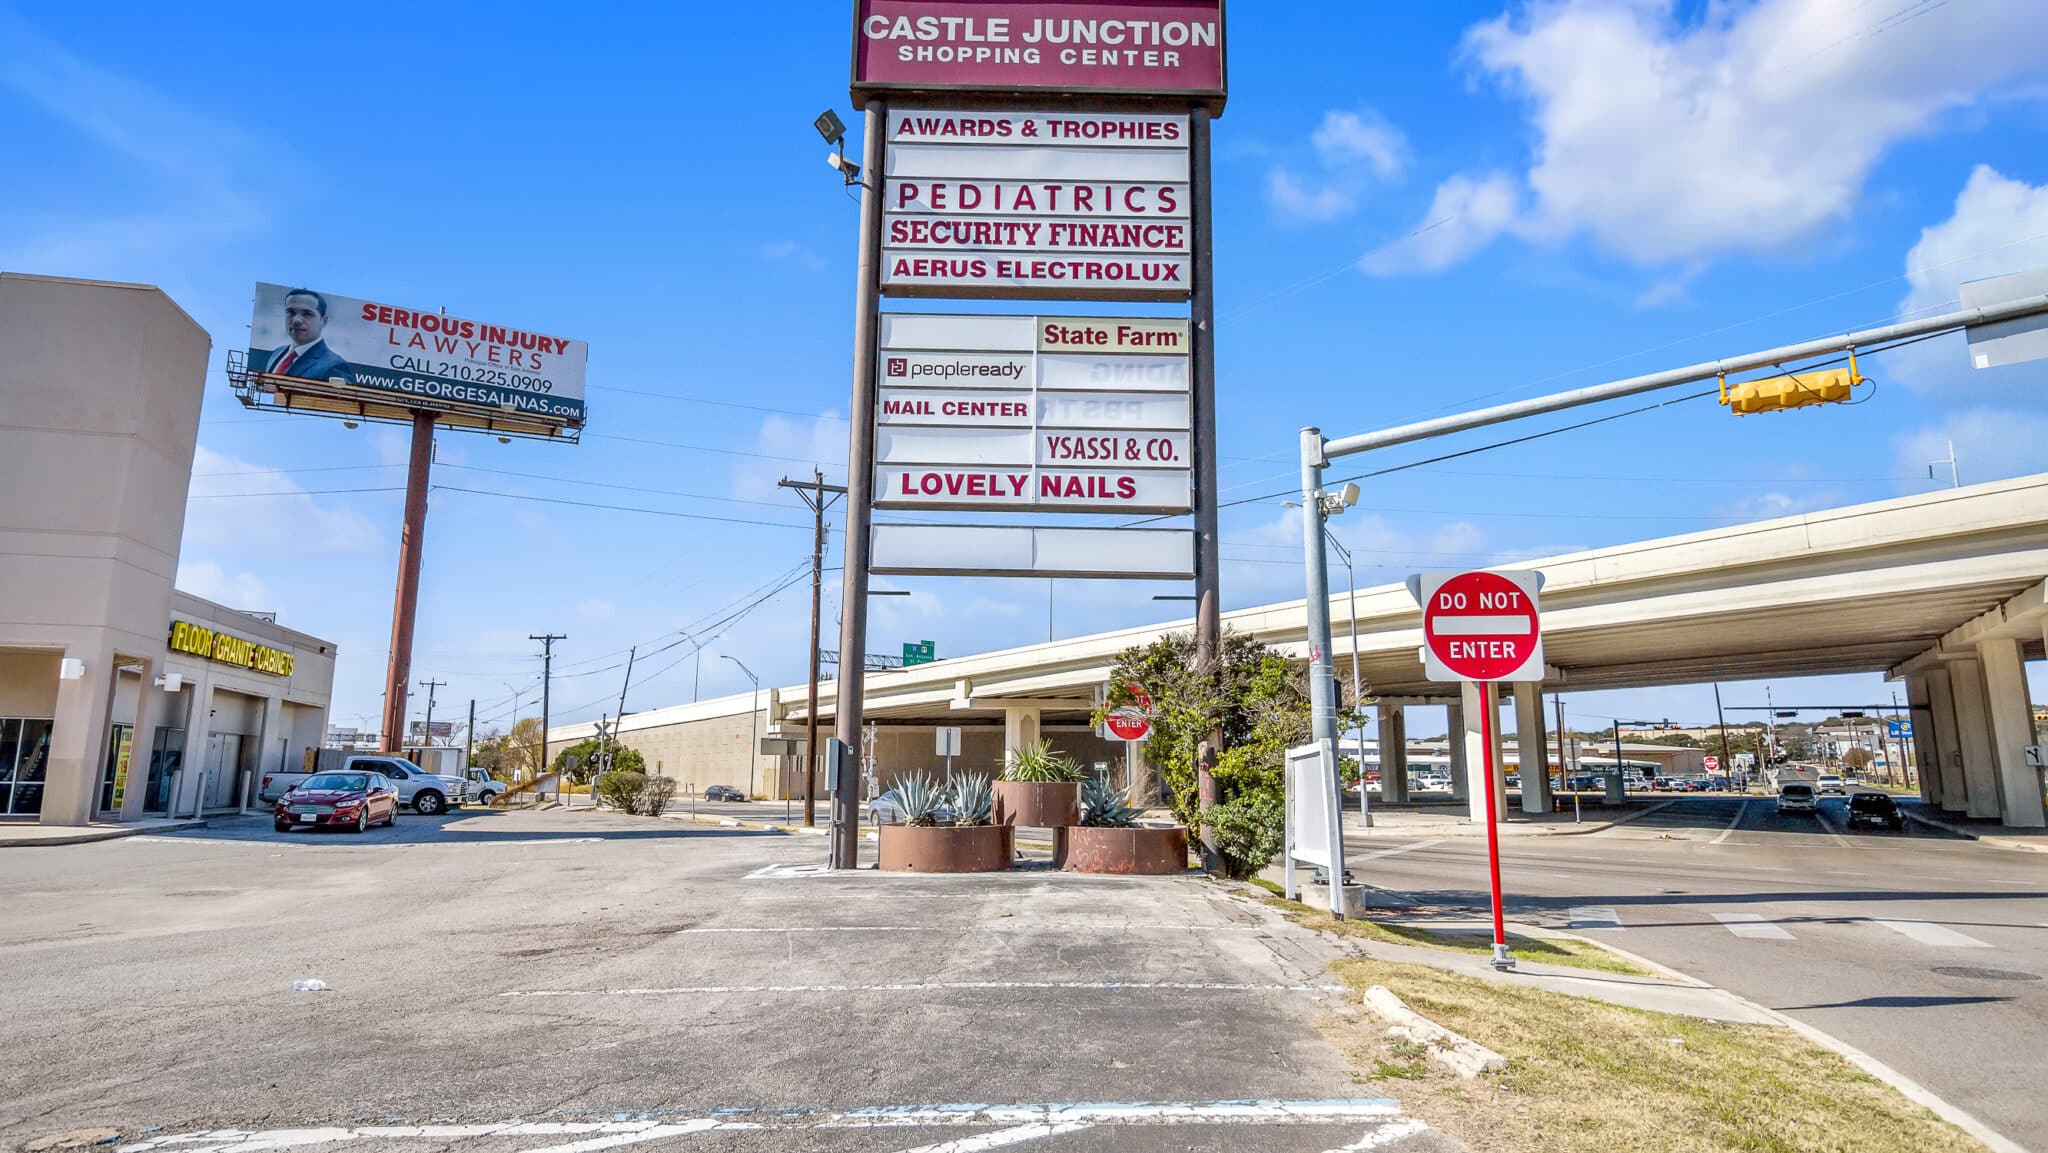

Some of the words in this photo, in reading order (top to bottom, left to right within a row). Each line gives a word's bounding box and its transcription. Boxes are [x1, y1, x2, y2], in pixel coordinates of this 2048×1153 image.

[863, 15, 1010, 42] CASTLE
[1022, 18, 1216, 47] JUNCTION
[898, 45, 1041, 64] SHOPPING
[1060, 49, 1180, 67] CENTER
[897, 117, 1012, 137] AWARDS
[1021, 119, 1039, 138] &
[1047, 120, 1180, 140] TROPHIES
[899, 183, 1177, 213] PEDIATRICS
[890, 220, 1041, 246] SECURITY
[1048, 223, 1184, 249] FINANCE
[893, 259, 987, 278] AERUS
[997, 260, 1180, 282] ELECTROLUX
[361, 303, 475, 339] SERIOUS
[479, 324, 570, 355] INJURY
[1044, 323, 1108, 345] State
[389, 328, 542, 370] LAWYERS
[389, 354, 435, 375] CALL
[438, 362, 553, 393] 210.225.0909
[911, 361, 1024, 380] peopleready
[883, 400, 935, 416] MAIL
[942, 401, 1028, 417] CENTER
[1047, 436, 1118, 460] YSASSI
[1124, 438, 1141, 461] &
[1146, 438, 1179, 462] CO.
[902, 473, 1029, 497] LOVELY
[1041, 475, 1137, 500] NAILS
[1439, 592, 1467, 610] DO
[1479, 591, 1520, 609] NOT
[176, 623, 213, 657] FLOOR
[217, 634, 257, 668] GRANITE
[257, 645, 295, 677] CABINETS
[1449, 641, 1516, 659] ENTER
[1116, 719, 1142, 728] ENTER
